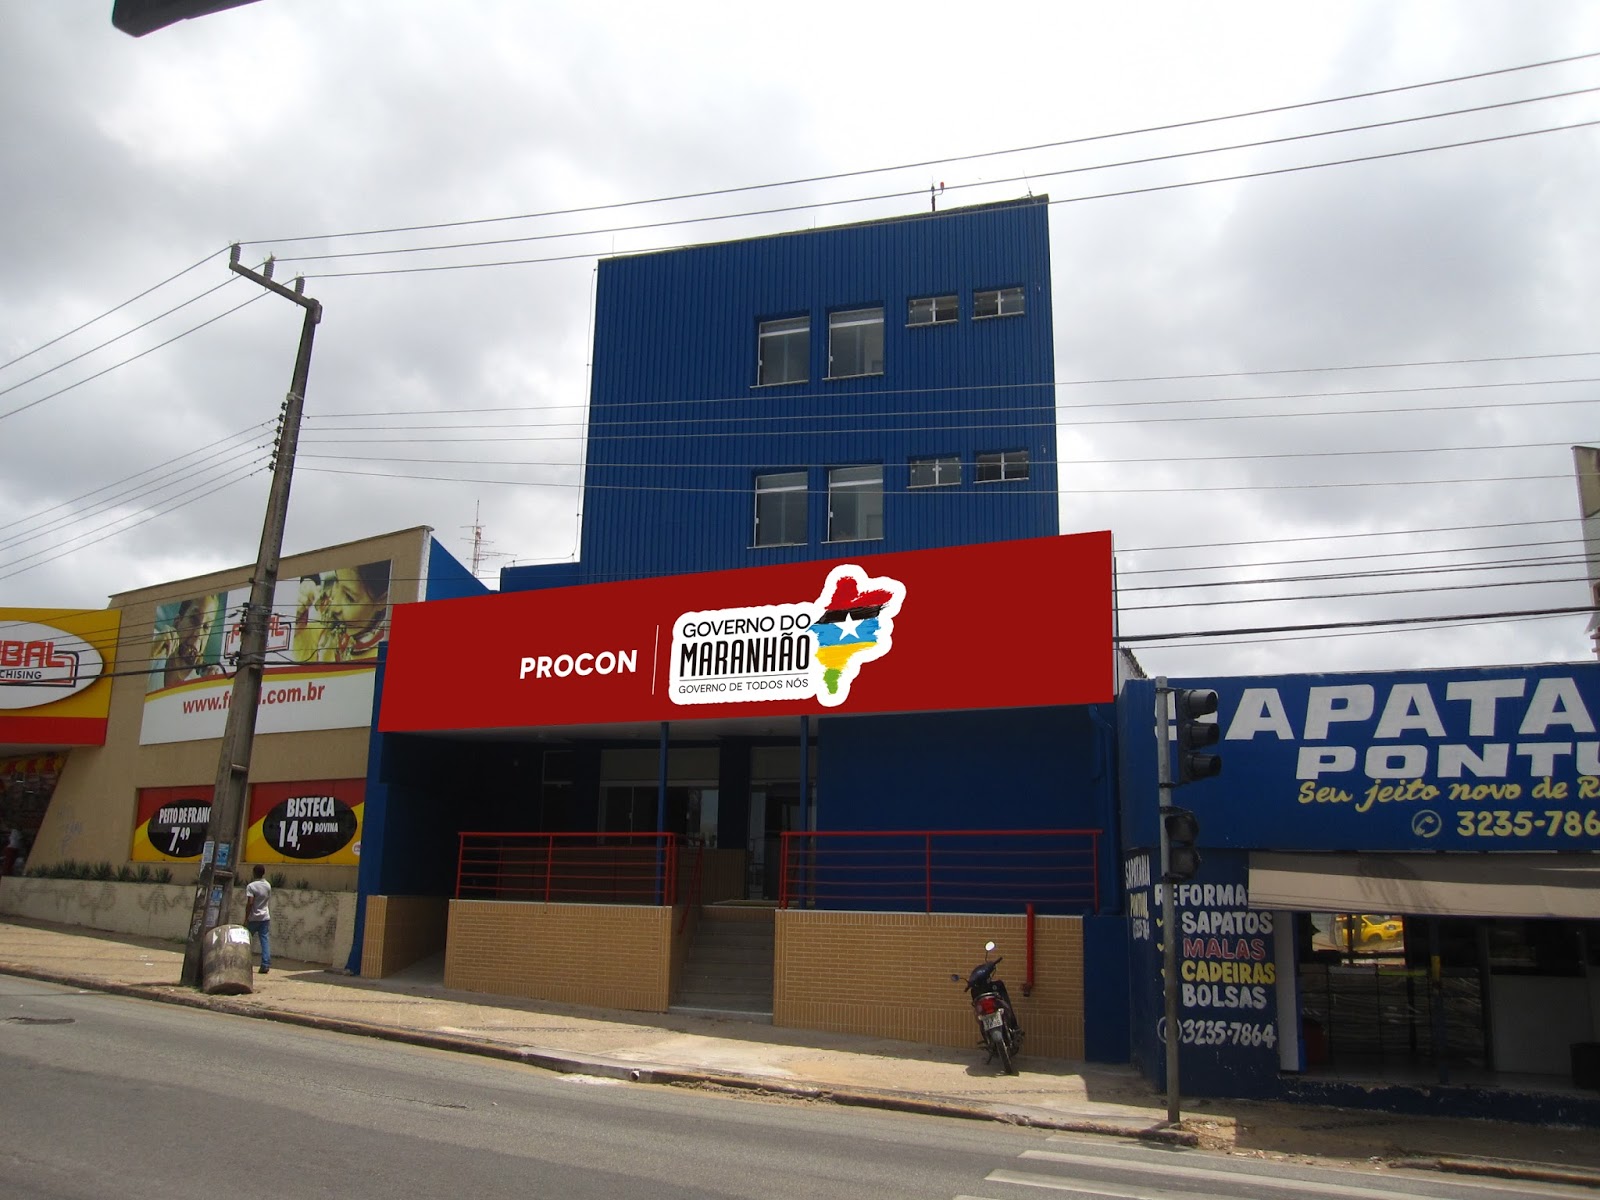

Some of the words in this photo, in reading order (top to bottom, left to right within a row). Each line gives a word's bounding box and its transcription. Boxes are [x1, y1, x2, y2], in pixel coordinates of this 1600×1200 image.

[682, 616, 775, 638] GOVERNO
[780, 613, 811, 631] DO
[0, 640, 65, 668] BAL
[519, 649, 638, 680] PROCON
[679, 632, 811, 677] MARANHÃO
[678, 683, 727, 694] GOVERNO
[729, 682, 743, 692] DE
[746, 680, 783, 690] TODOS
[786, 677, 809, 688] NÓS
[1298, 781, 1353, 804] Seu
[1355, 778, 1440, 812] jeito
[1448, 782, 1522, 800] novo
[1531, 775, 1568, 799] de
[1577, 775, 1600, 799] R
[159, 808, 179, 824] PEITO
[178, 807, 188, 823] DE
[286, 797, 336, 818] BISTECA
[315, 822, 339, 833] BOVINA
[1181, 911, 1273, 935] SAPATOS
[1182, 938, 1266, 960] MALAS
[1181, 960, 1276, 984] CADEIRAS
[1181, 983, 1267, 1009] BOLSAS
